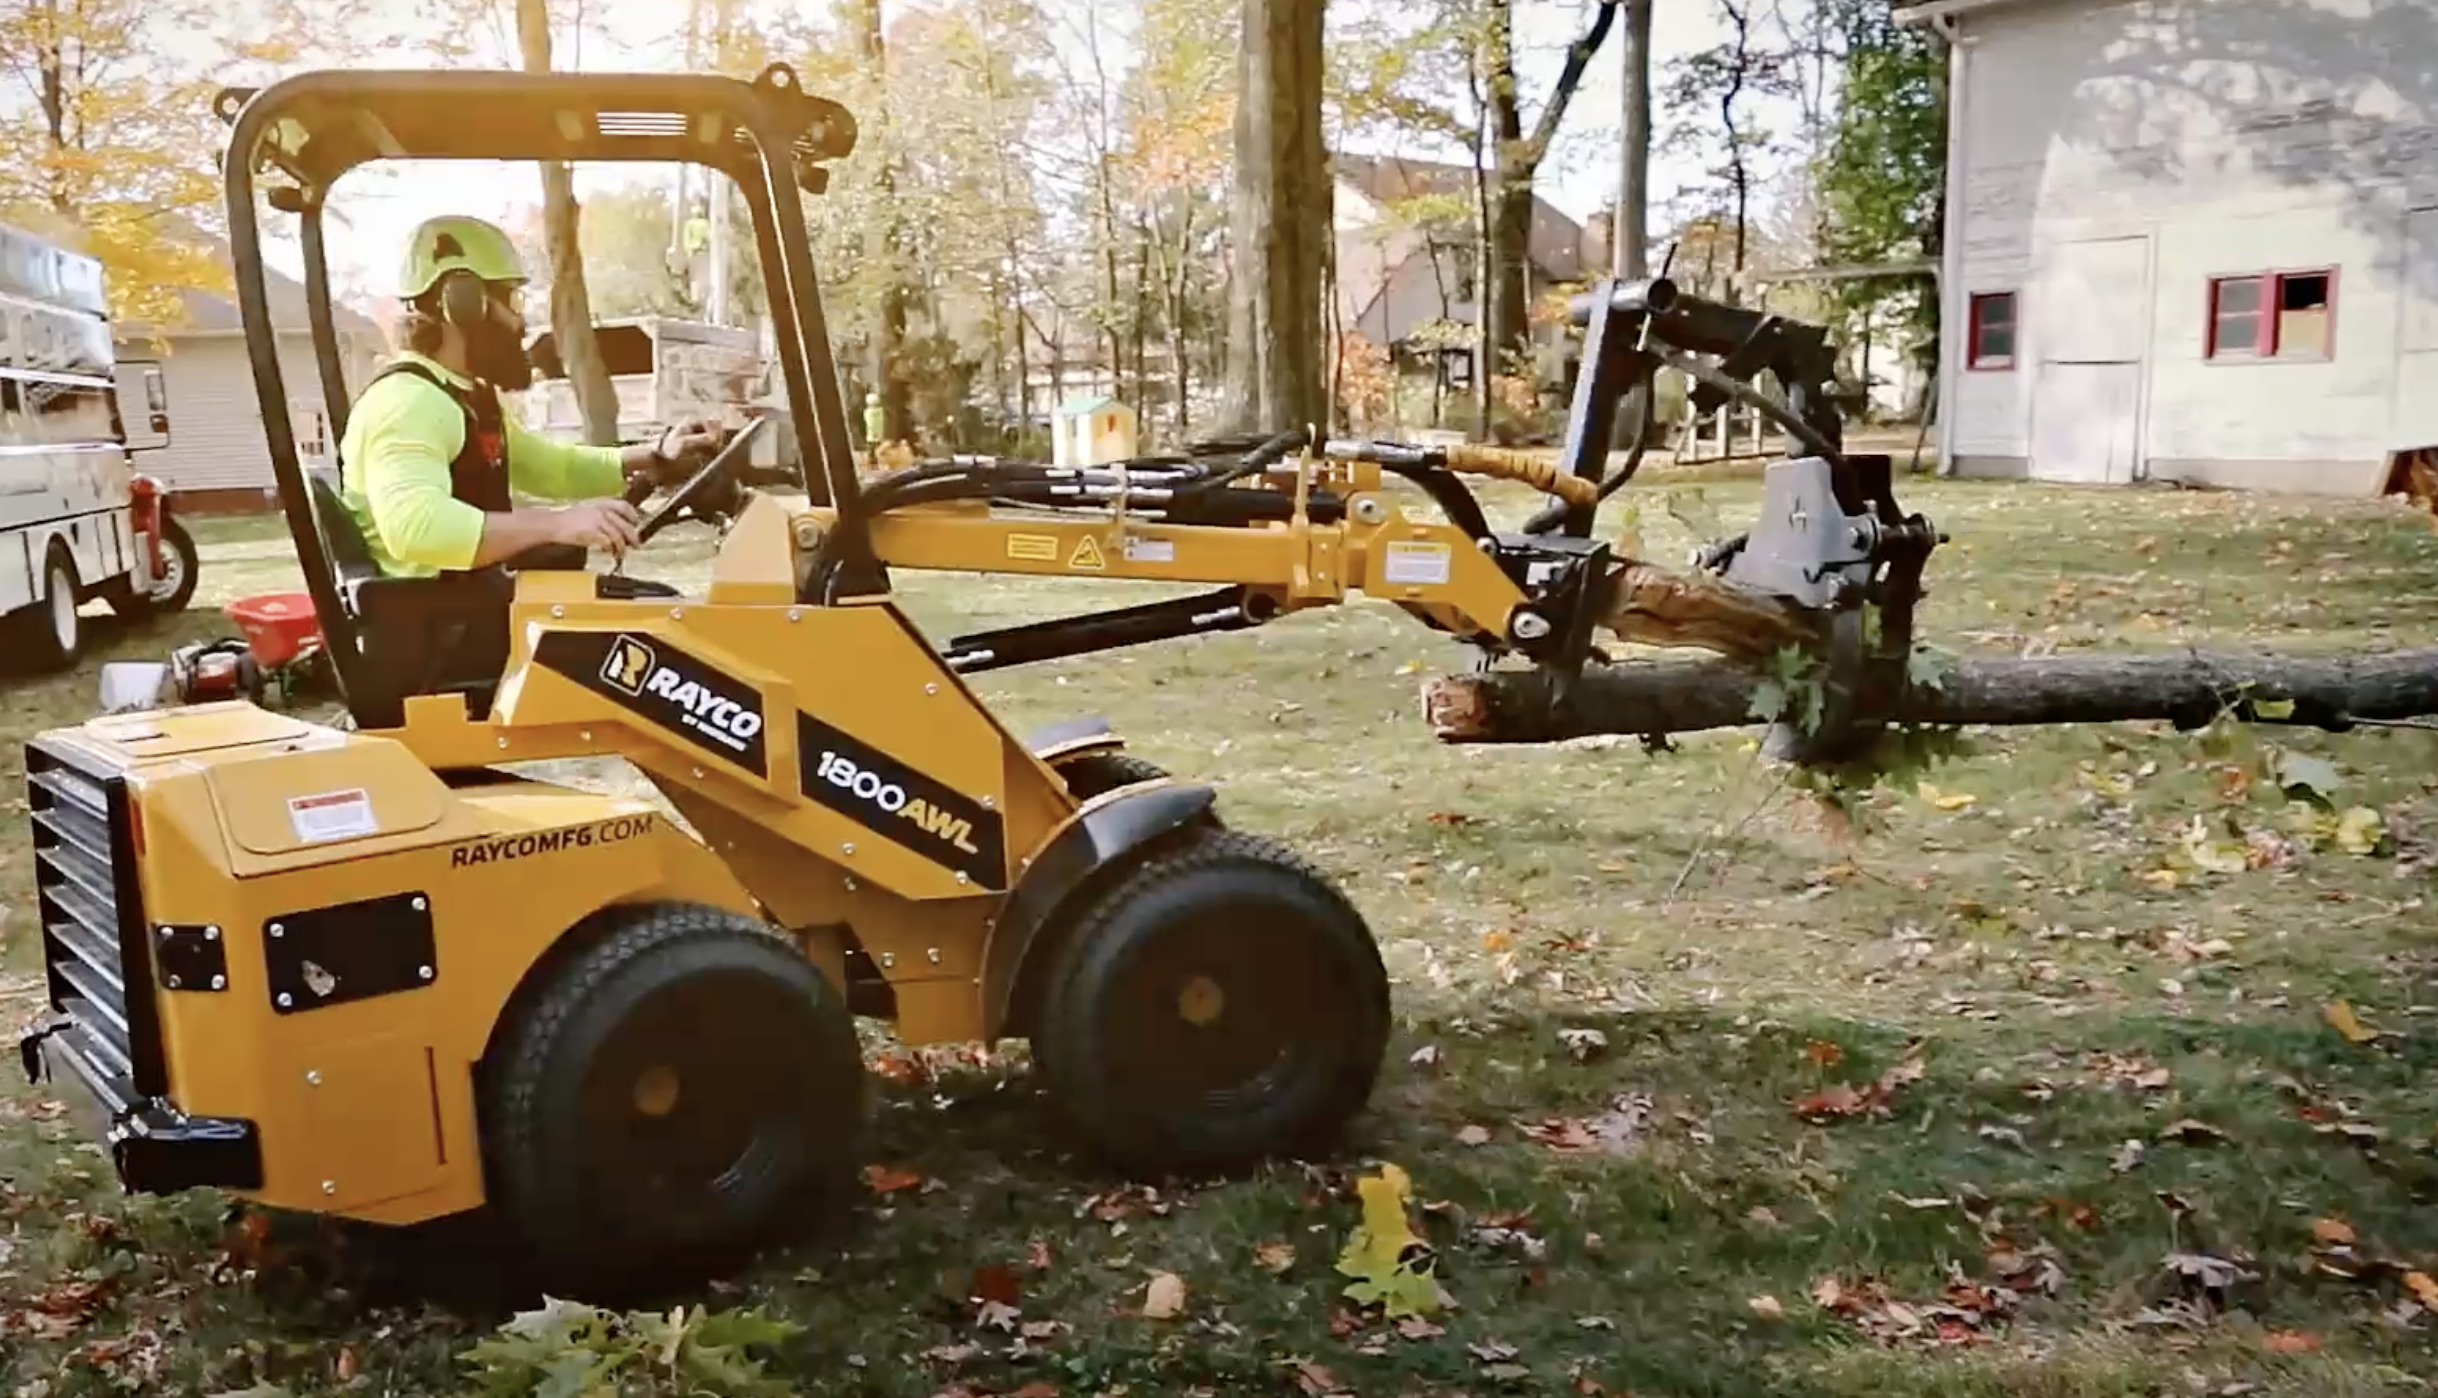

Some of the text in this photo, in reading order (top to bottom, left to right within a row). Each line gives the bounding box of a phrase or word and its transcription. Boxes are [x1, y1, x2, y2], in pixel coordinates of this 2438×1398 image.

[647, 667, 761, 738] RAYCO
[817, 751, 979, 855] 1800AWL
[451, 815, 653, 869] RAYCOMFG.COM
